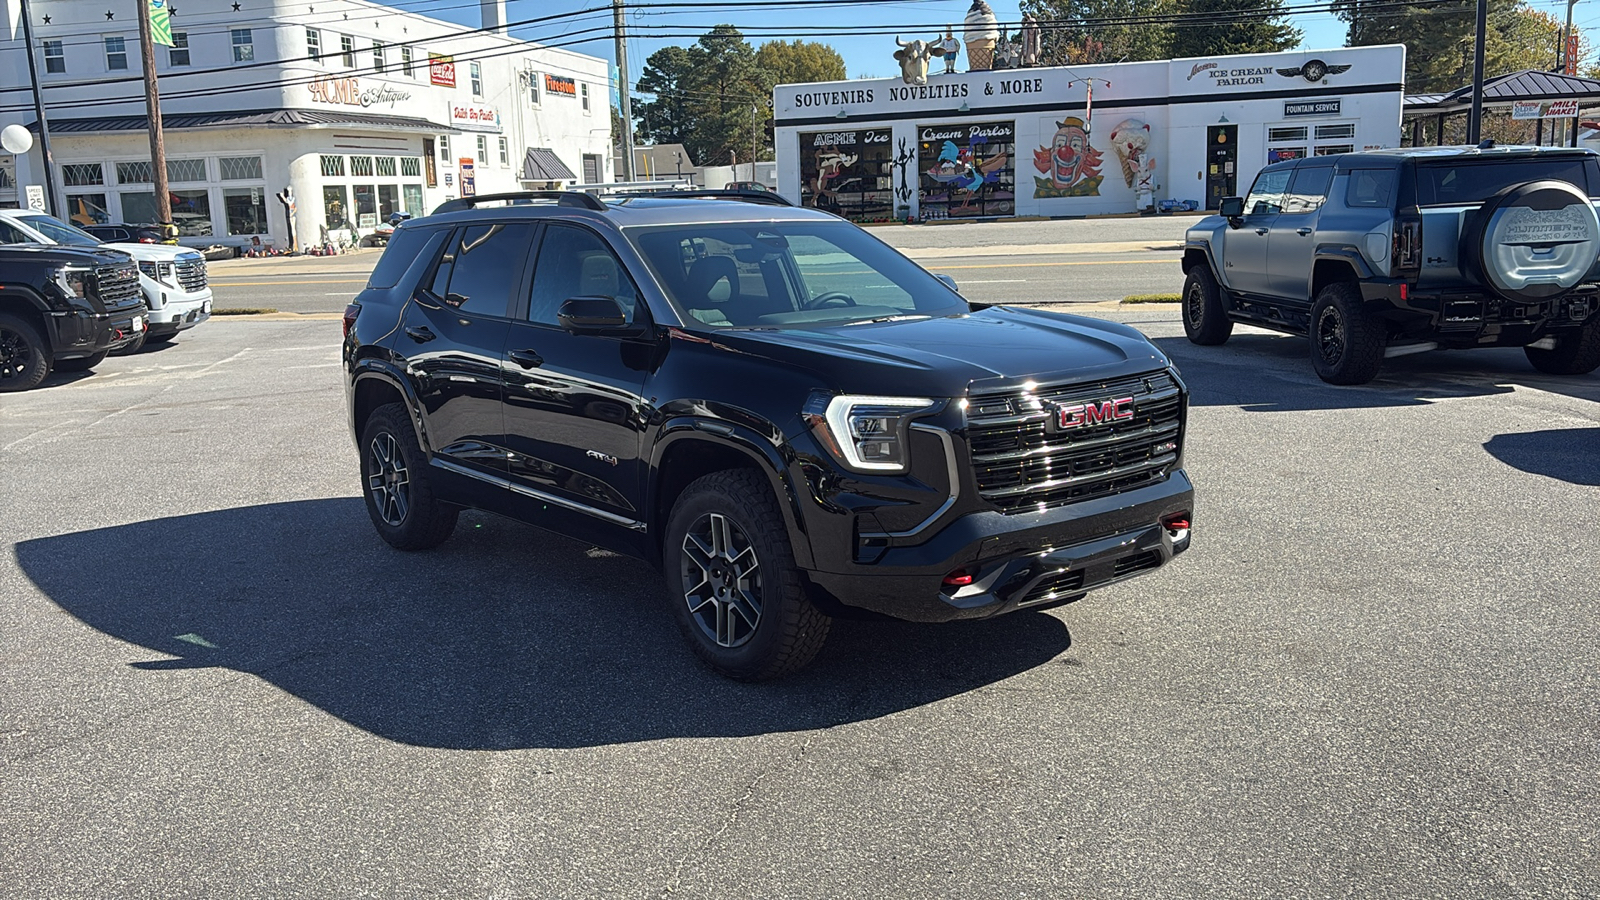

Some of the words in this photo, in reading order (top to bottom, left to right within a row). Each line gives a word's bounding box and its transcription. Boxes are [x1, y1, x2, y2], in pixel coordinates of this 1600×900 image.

[1208, 70, 1228, 78] ICE
[1230, 67, 1273, 77] CREAM
[1216, 77, 1264, 87] PARLOR
[307, 73, 360, 106] ACME
[360, 82, 411, 109] Antiques
[795, 89, 874, 108] SOUVENIRS
[889, 83, 969, 102] NOVELTIES
[984, 82, 994, 96] &
[1000, 78, 1043, 95] MORE
[1286, 104, 1315, 114] FOUNTAIN
[1315, 102, 1339, 112] SERVICE
[1552, 100, 1578, 108] MILK
[454, 107, 468, 119] Dutch
[469, 108, 478, 122] Boy
[1545, 107, 1577, 116] SHAKES
[814, 132, 856, 146] ACME
[864, 130, 890, 144] Ice
[922, 128, 963, 141] Cream
[968, 125, 1012, 139] Parlor
[464, 182, 475, 194] TEA
[30, 198, 43, 208] 25
[1508, 224, 1572, 233] HUMMER
[1058, 397, 1134, 430] GMC
[586, 450, 618, 467] AT4
